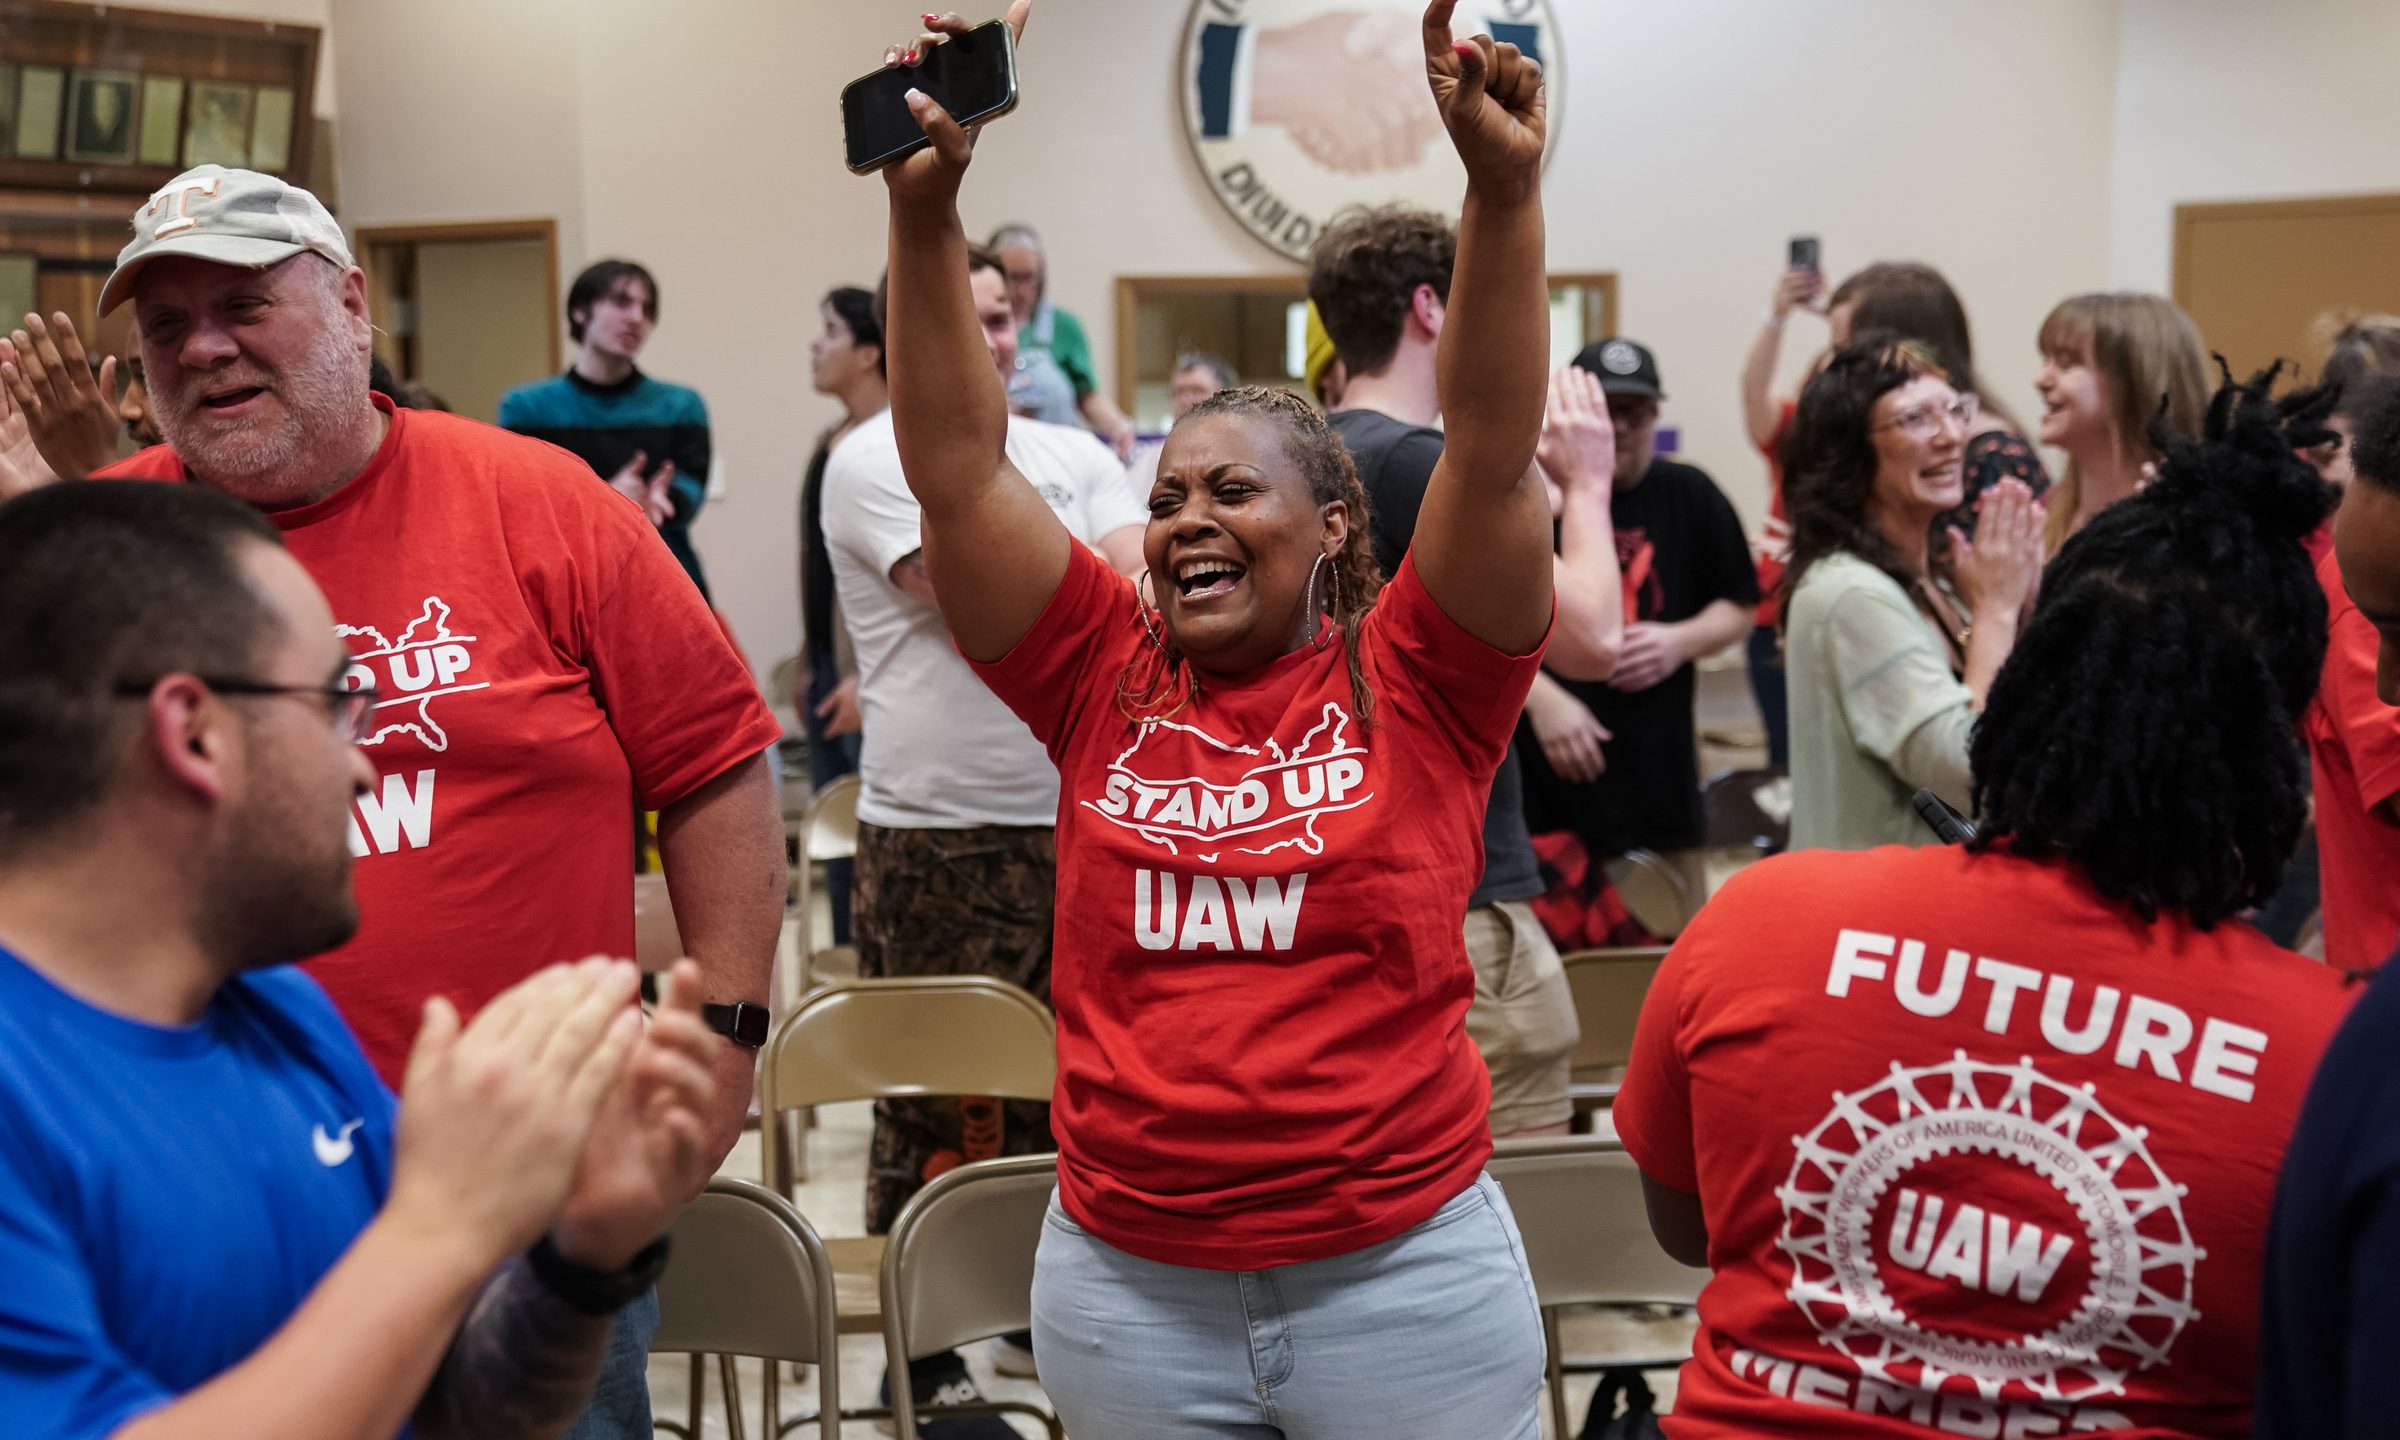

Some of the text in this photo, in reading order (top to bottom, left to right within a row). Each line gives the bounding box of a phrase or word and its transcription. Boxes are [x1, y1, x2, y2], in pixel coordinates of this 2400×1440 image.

[145, 177, 221, 240] T
[388, 643, 471, 692] UP
[1095, 757, 1364, 832] STAND UP
[1134, 868, 1309, 951] UAW
[1825, 928, 2269, 1103] FUTURE
[1890, 1129, 1919, 1152] OF
[1921, 1119, 2009, 1140] AMERICA
[2011, 1128, 2080, 1175] UNITED
[1836, 1143, 1896, 1214] WORKERS
[1887, 1188, 2074, 1303] UAW
[2075, 1172, 2127, 1288] AUTOMOBILE
